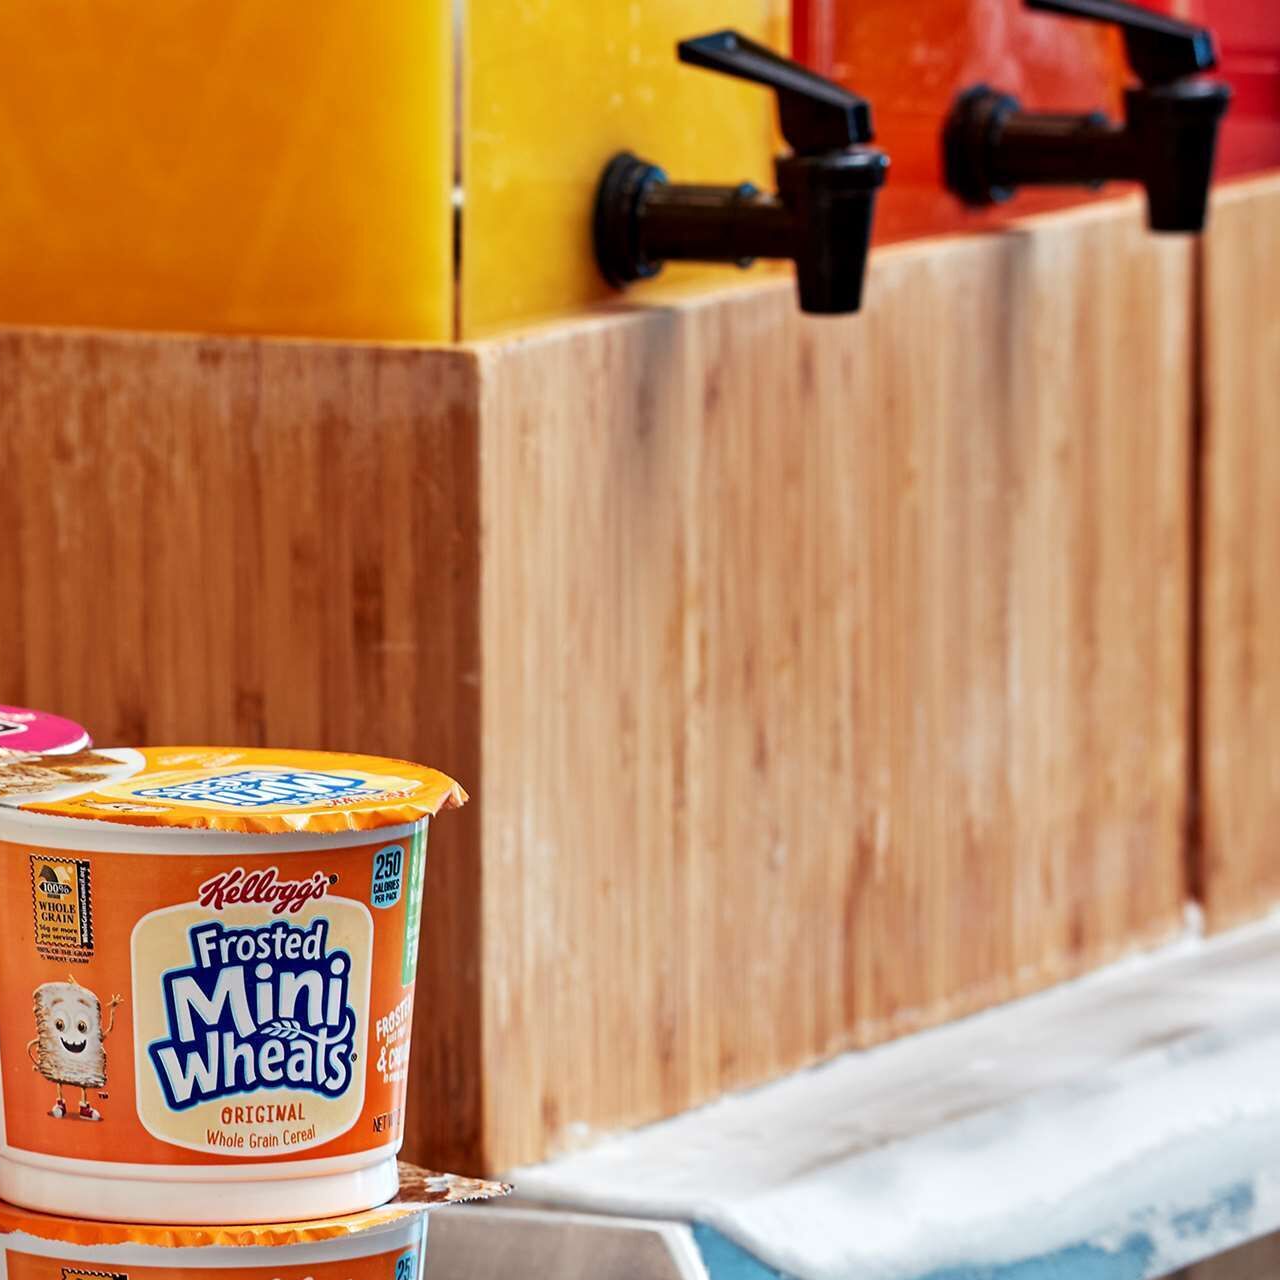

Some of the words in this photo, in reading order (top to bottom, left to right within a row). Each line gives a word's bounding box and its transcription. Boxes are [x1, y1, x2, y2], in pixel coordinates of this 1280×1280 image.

[375, 850, 402, 880] 250
[43, 883, 70, 894] 100%
[199, 869, 328, 914] Kellogg's
[373, 878, 400, 894] CALORIES
[374, 893, 385, 903] PER
[385, 891, 397, 902] PACK
[38, 901, 77, 914] WHOLE
[41, 912, 75, 924] GRAIN
[196, 923, 326, 969] Frosted
[171, 951, 343, 1043] Mini
[158, 1015, 351, 1103] Wheats
[377, 1046, 388, 1072] &
[221, 1102, 306, 1125] ORIGINAL
[206, 1128, 245, 1149] Whole
[249, 1130, 280, 1149] Grain
[283, 1124, 316, 1145] Cereal
